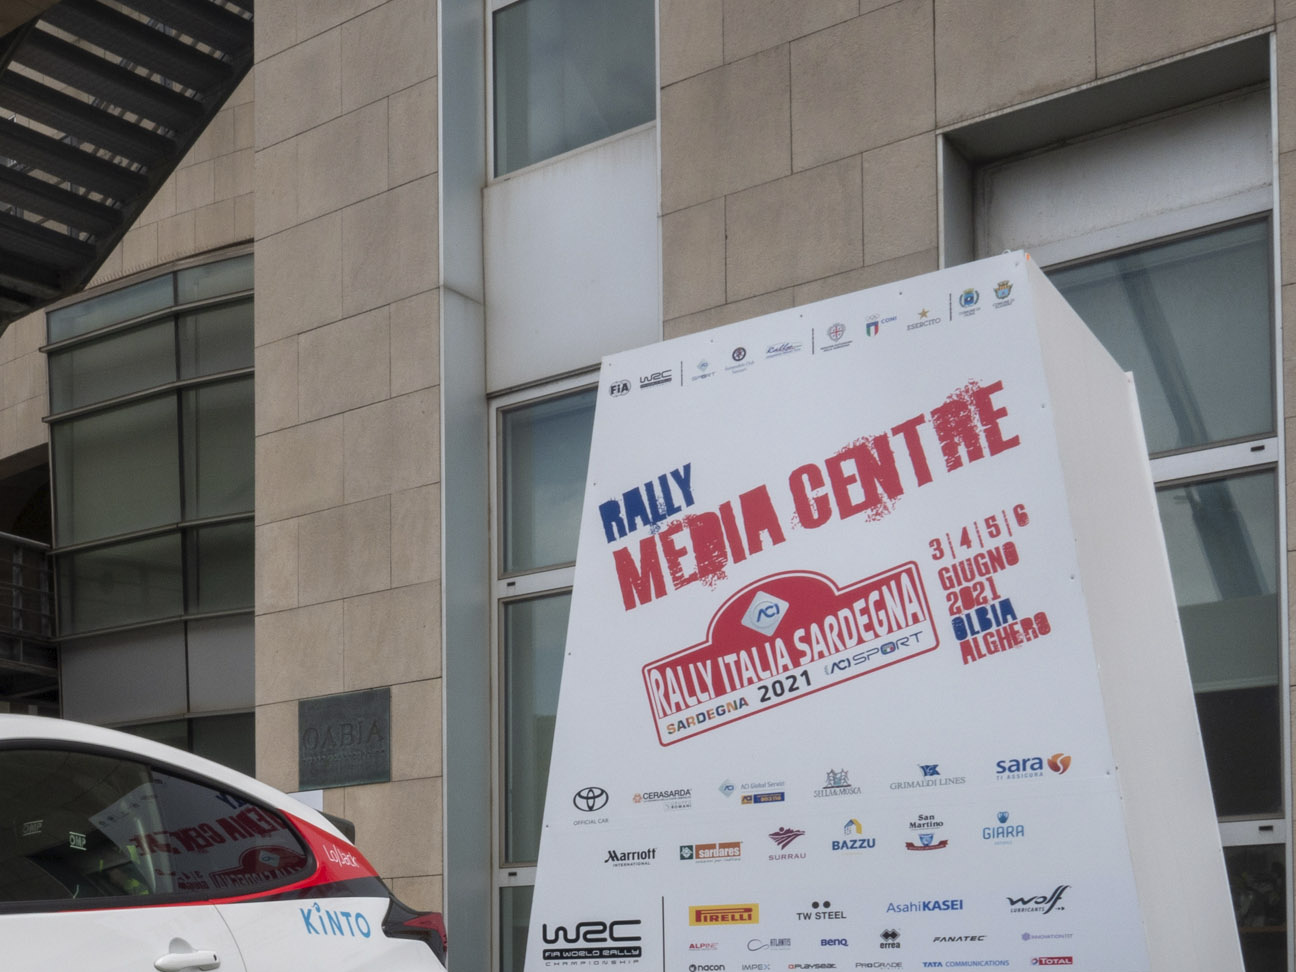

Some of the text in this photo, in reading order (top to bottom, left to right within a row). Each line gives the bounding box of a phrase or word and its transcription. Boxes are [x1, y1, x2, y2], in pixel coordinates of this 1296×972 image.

[881, 316, 897, 324] CONI
[906, 317, 941, 331] ESERCITO
[640, 369, 672, 383] WRC
[598, 462, 695, 543] RALLY
[612, 379, 1021, 612] MEDIA CENTRE
[937, 541, 1019, 591] GIUGNO
[945, 576, 1001, 616] 2021
[756, 603, 780, 623] ACI
[951, 597, 1018, 641] OLBIA
[649, 572, 927, 719] RALLY ITALIA SARDEGNA
[960, 612, 1051, 665] ALGHERO
[666, 697, 750, 735] SARDEGNA
[757, 669, 813, 703] 2021
[995, 756, 1044, 774] sara
[890, 776, 966, 790] GRIMALDI LINES
[642, 788, 691, 800] CERASARDA
[573, 818, 597, 826] OFFICIAL
[918, 813, 935, 821] San
[909, 820, 944, 829] Martino
[982, 825, 1025, 840] GIARA
[69, 834, 87, 848] OMP
[831, 838, 876, 850] BAZZU
[604, 848, 656, 863] Marriott
[698, 843, 740, 858] sardares
[768, 852, 807, 861] SURRAU
[695, 907, 753, 923] PIRELLI
[797, 911, 847, 921] TW STEEL
[542, 919, 642, 944] WRC
[933, 935, 985, 943] FANATEC
[602, 948, 639, 956] RALLY
[545, 959, 639, 967] CHAMPIONSHIP
[742, 963, 770, 971] IMPEX
[945, 960, 1010, 968] COMMUNICATIONS
[1040, 957, 1073, 965] TOTAL
